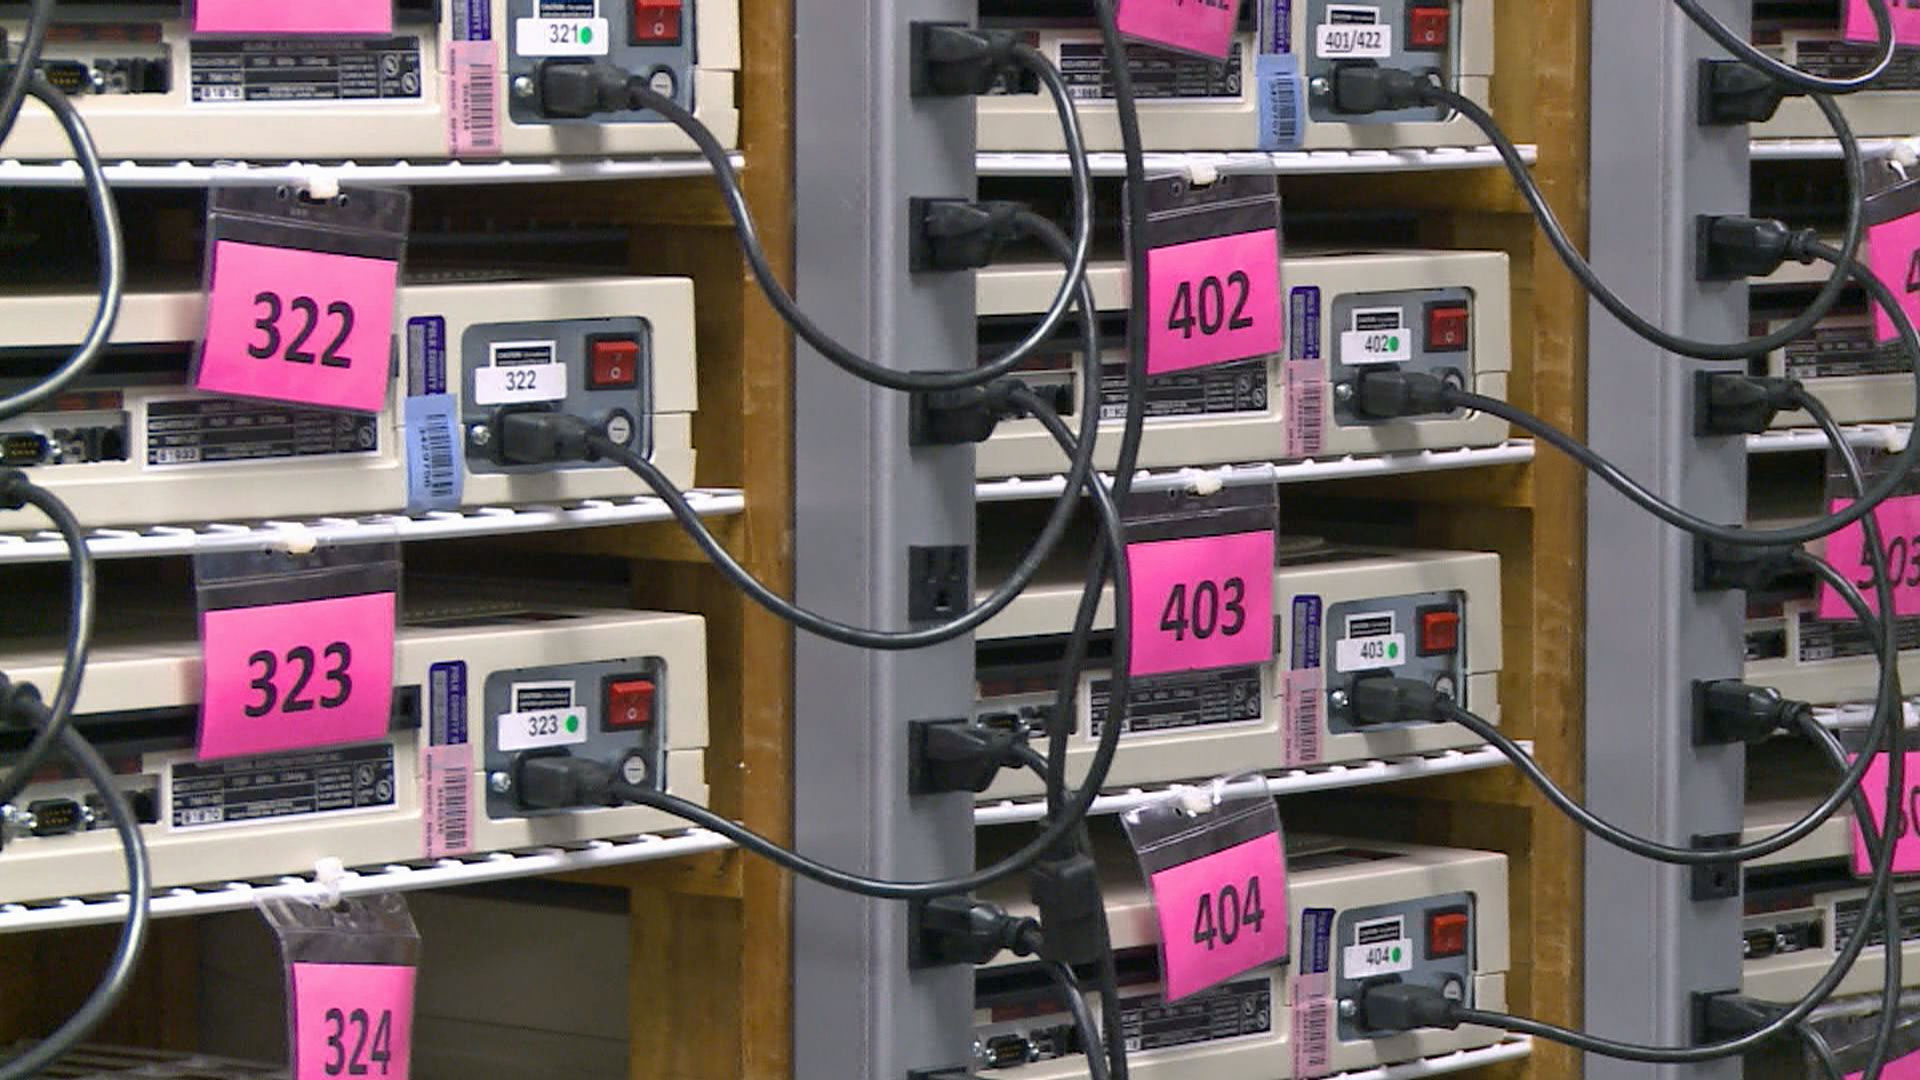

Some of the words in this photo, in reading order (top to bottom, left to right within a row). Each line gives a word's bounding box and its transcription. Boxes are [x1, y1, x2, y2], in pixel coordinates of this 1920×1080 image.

[549, 24, 579, 44] 321
[1325, 31, 1381, 51] 401/422
[1167, 270, 1254, 339] 402
[248, 292, 353, 369] 322
[1364, 334, 1389, 353] 402
[505, 370, 537, 391] 322
[1159, 577, 1245, 641] 403
[1359, 641, 1384, 660] 403
[244, 641, 352, 718] 323
[528, 714, 559, 737] 323
[1193, 876, 1265, 950] 404
[1366, 946, 1390, 967] 404
[325, 1008, 391, 1076] 324
